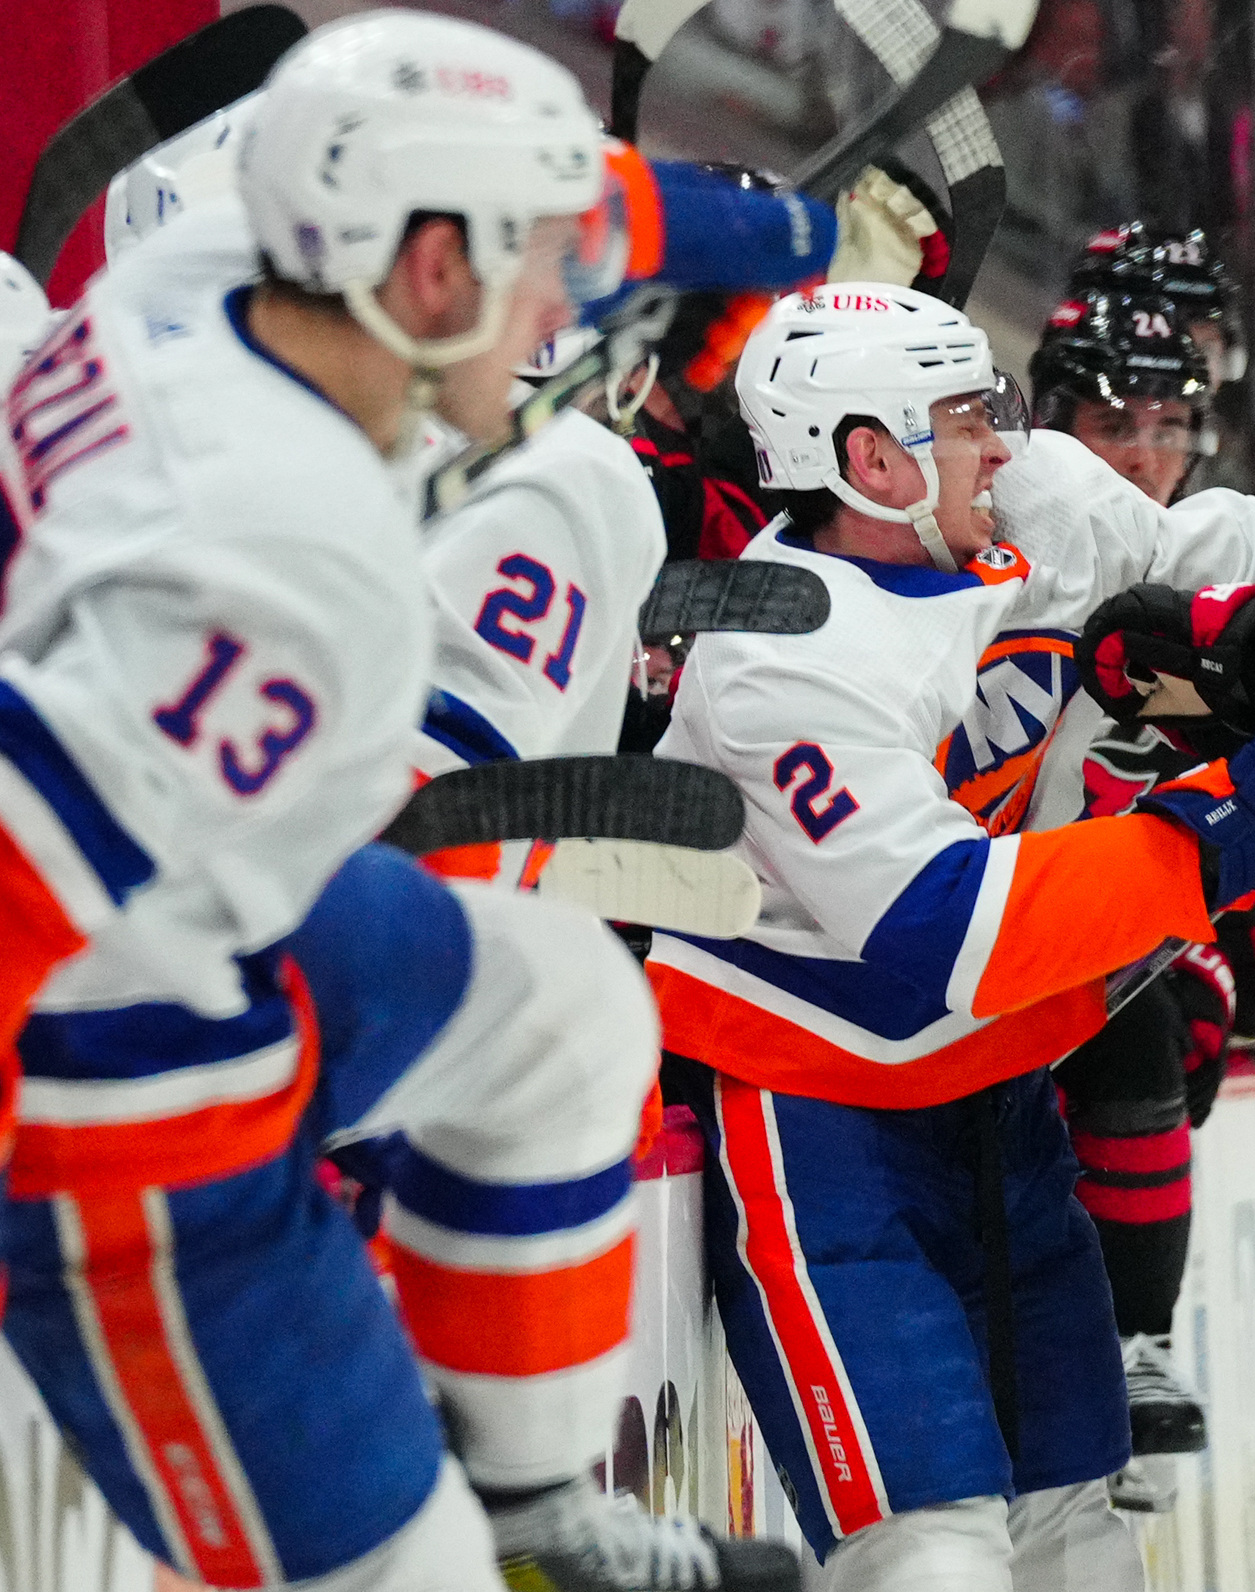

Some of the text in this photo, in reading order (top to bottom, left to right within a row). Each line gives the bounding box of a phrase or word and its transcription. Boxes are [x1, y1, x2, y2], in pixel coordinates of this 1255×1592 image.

[833, 295, 889, 312] UBS
[1132, 310, 1173, 338] 24
[474, 553, 587, 693] 21
[152, 627, 319, 795] 13
[772, 739, 861, 846] 2
